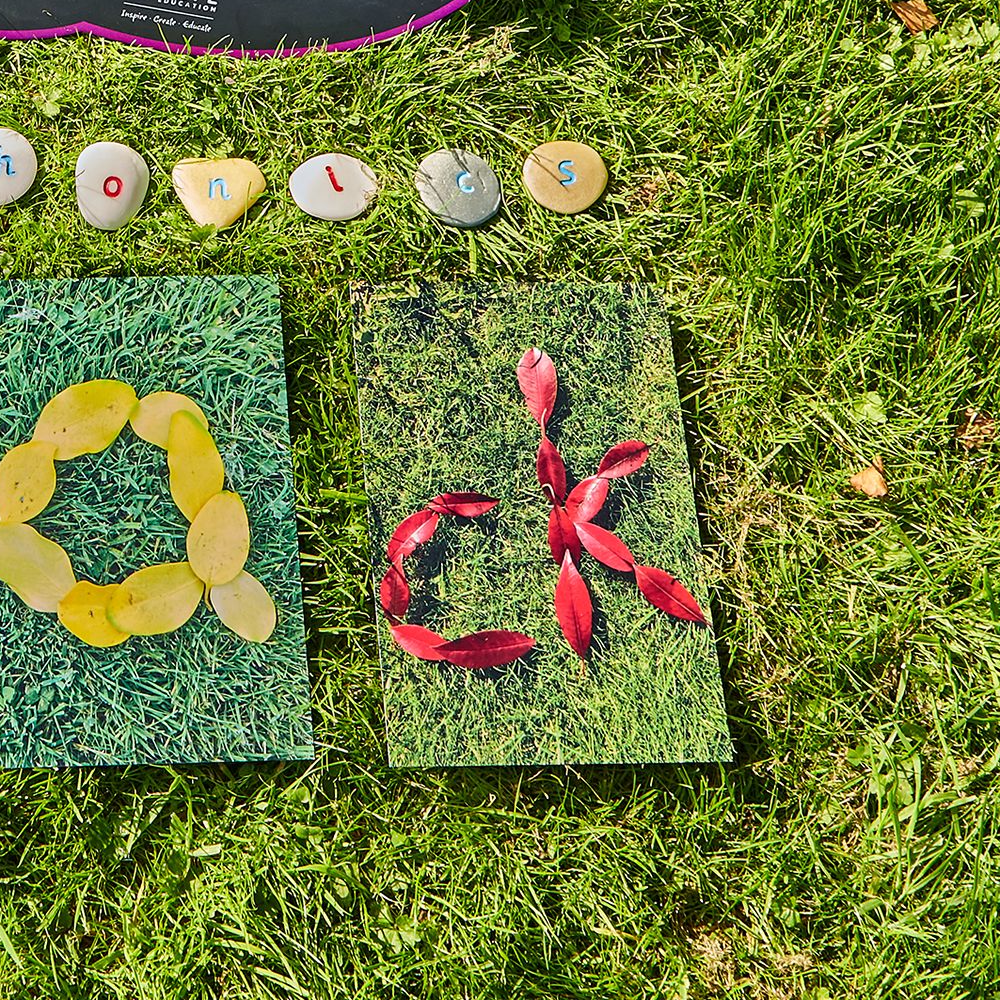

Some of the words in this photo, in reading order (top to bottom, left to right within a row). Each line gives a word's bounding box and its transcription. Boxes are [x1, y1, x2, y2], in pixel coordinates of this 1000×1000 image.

[120, 9, 148, 23] Inspire
[153, 15, 177, 27] Create
[182, 20, 212, 33] Educate
